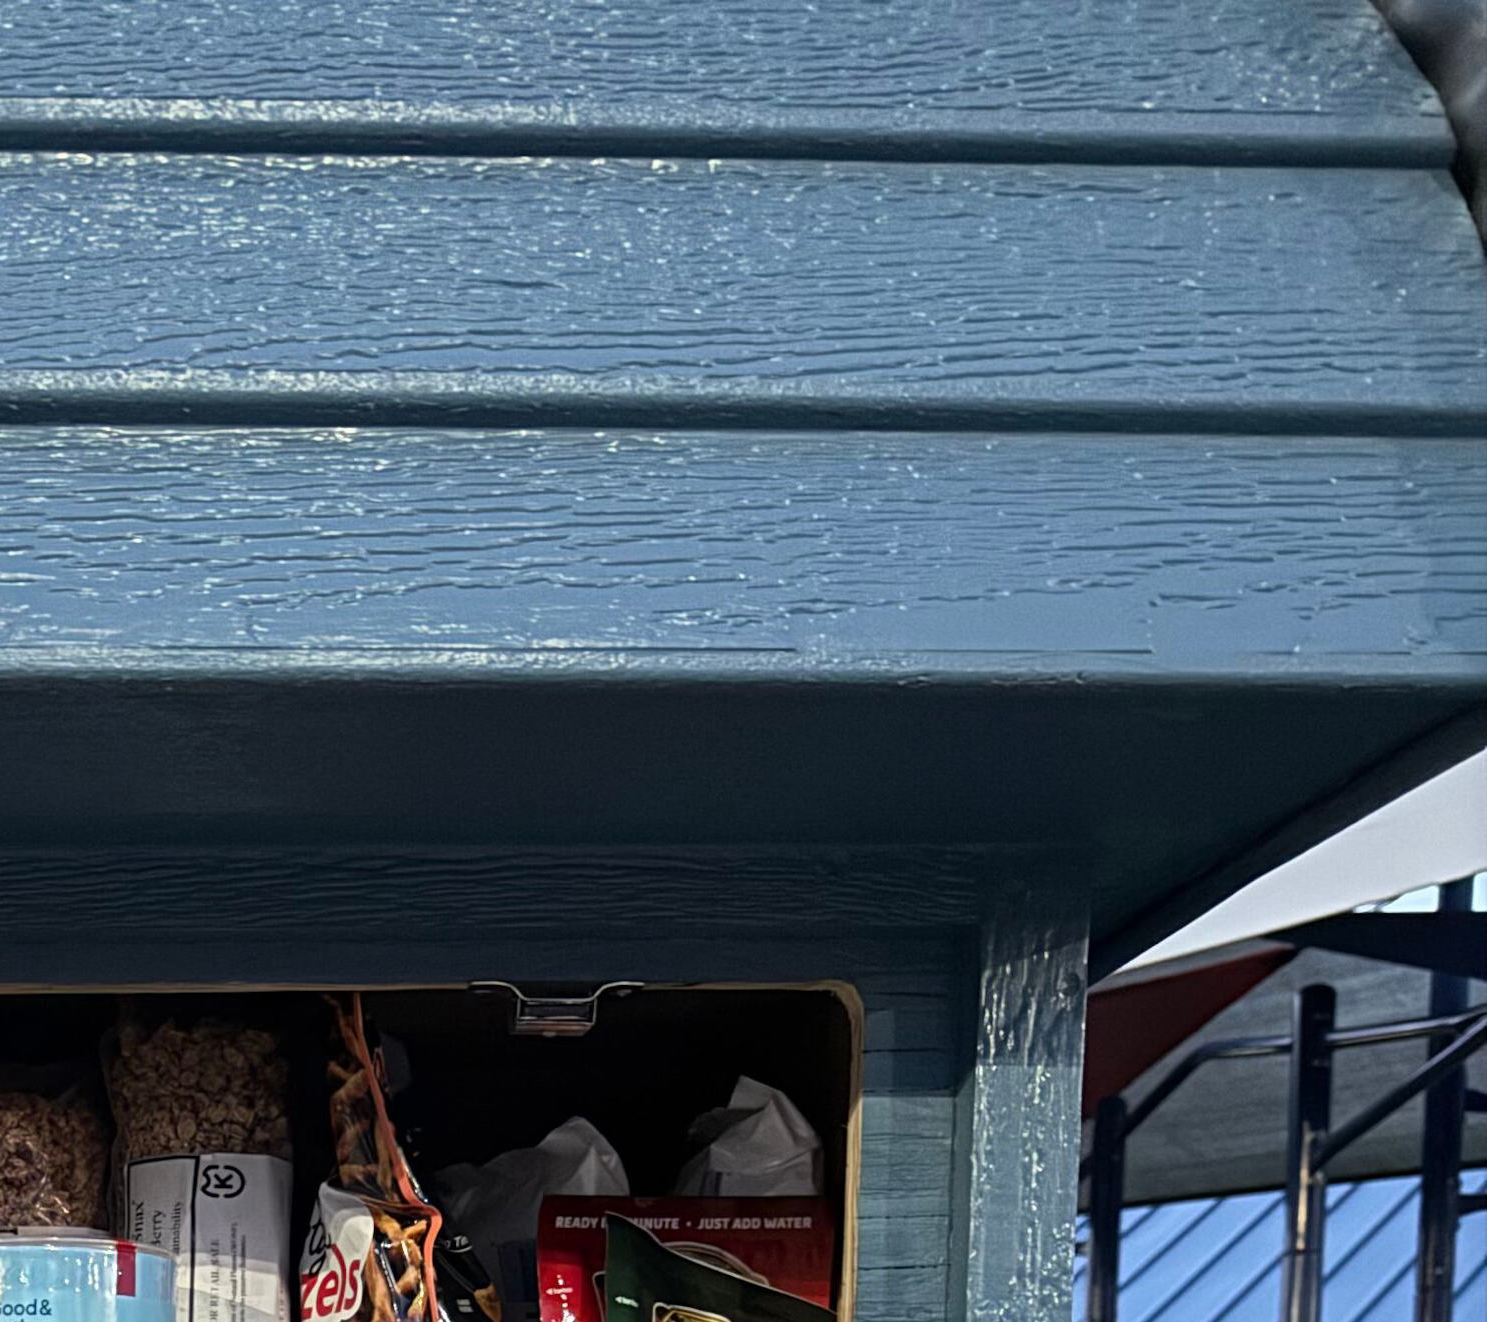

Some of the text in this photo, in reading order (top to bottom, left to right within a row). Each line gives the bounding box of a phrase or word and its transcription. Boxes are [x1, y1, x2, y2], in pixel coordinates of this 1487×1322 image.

[697, 1217, 730, 1230] JUST
[732, 1217, 761, 1229] ADD
[763, 1216, 813, 1229] WATER
